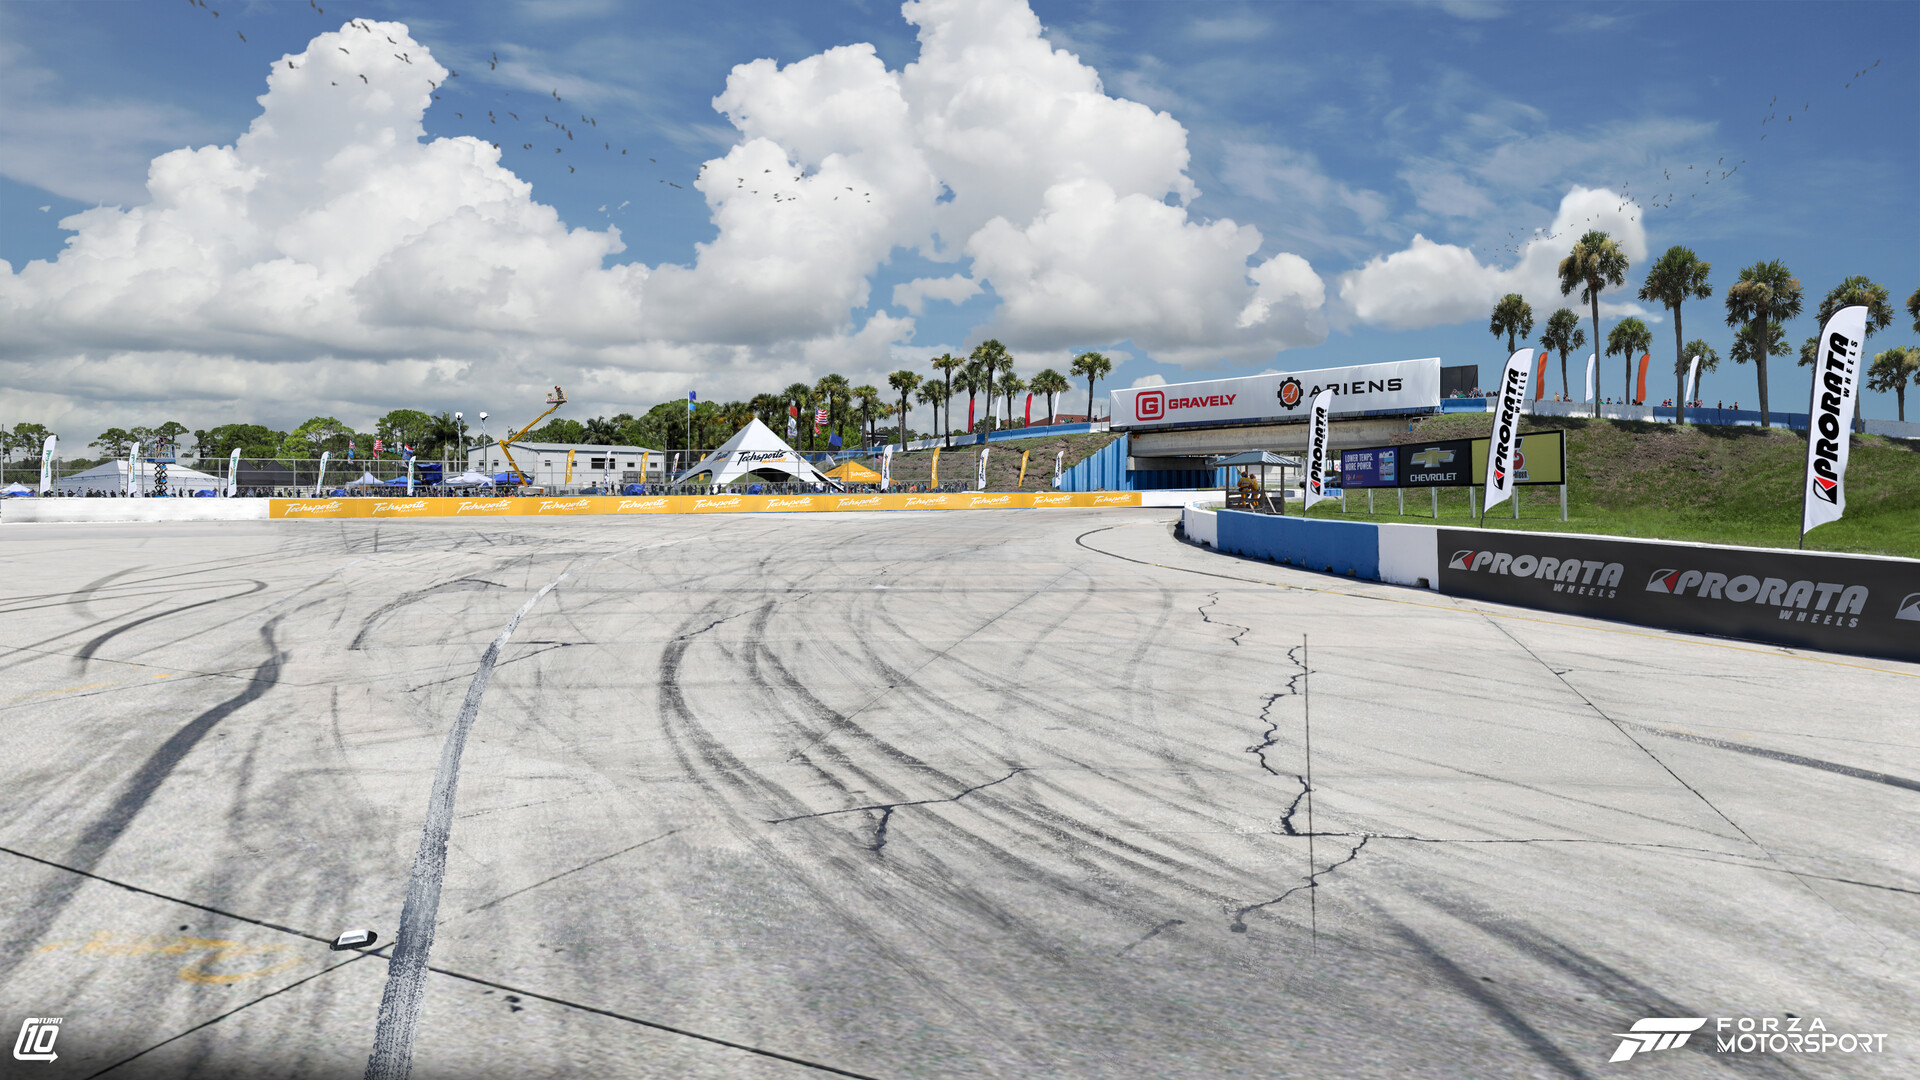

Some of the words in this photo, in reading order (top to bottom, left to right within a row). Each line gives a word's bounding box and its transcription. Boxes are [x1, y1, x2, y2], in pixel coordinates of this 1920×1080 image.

[1843, 340, 1858, 398] WHEELS
[1308, 378, 1402, 398] ARIENS
[1515, 372, 1527, 414] WHEELS
[1168, 394, 1237, 409] GRAVELY
[1814, 332, 1849, 481] PRORATA
[1495, 368, 1519, 473] PRORATA
[1311, 406, 1325, 483] PRORATA
[737, 449, 787, 466] Techsports
[1345, 454, 1358, 462] LOWER
[1345, 462, 1356, 470] MORE
[1410, 472, 1457, 482] CHEVROLET
[285, 501, 343, 516] Techsports
[372, 500, 429, 514] Techsports
[457, 499, 512, 514] Techsports
[538, 499, 591, 513] Techsports
[617, 498, 669, 512] Techsports
[693, 497, 742, 511] Techsports
[766, 496, 814, 510] Techsports
[836, 496, 883, 509] Techsports
[1470, 551, 1625, 587] PRORATA
[1553, 583, 1616, 599] WHEELS
[1673, 570, 1869, 615] PRORATA
[1779, 609, 1859, 628] WHEELS
